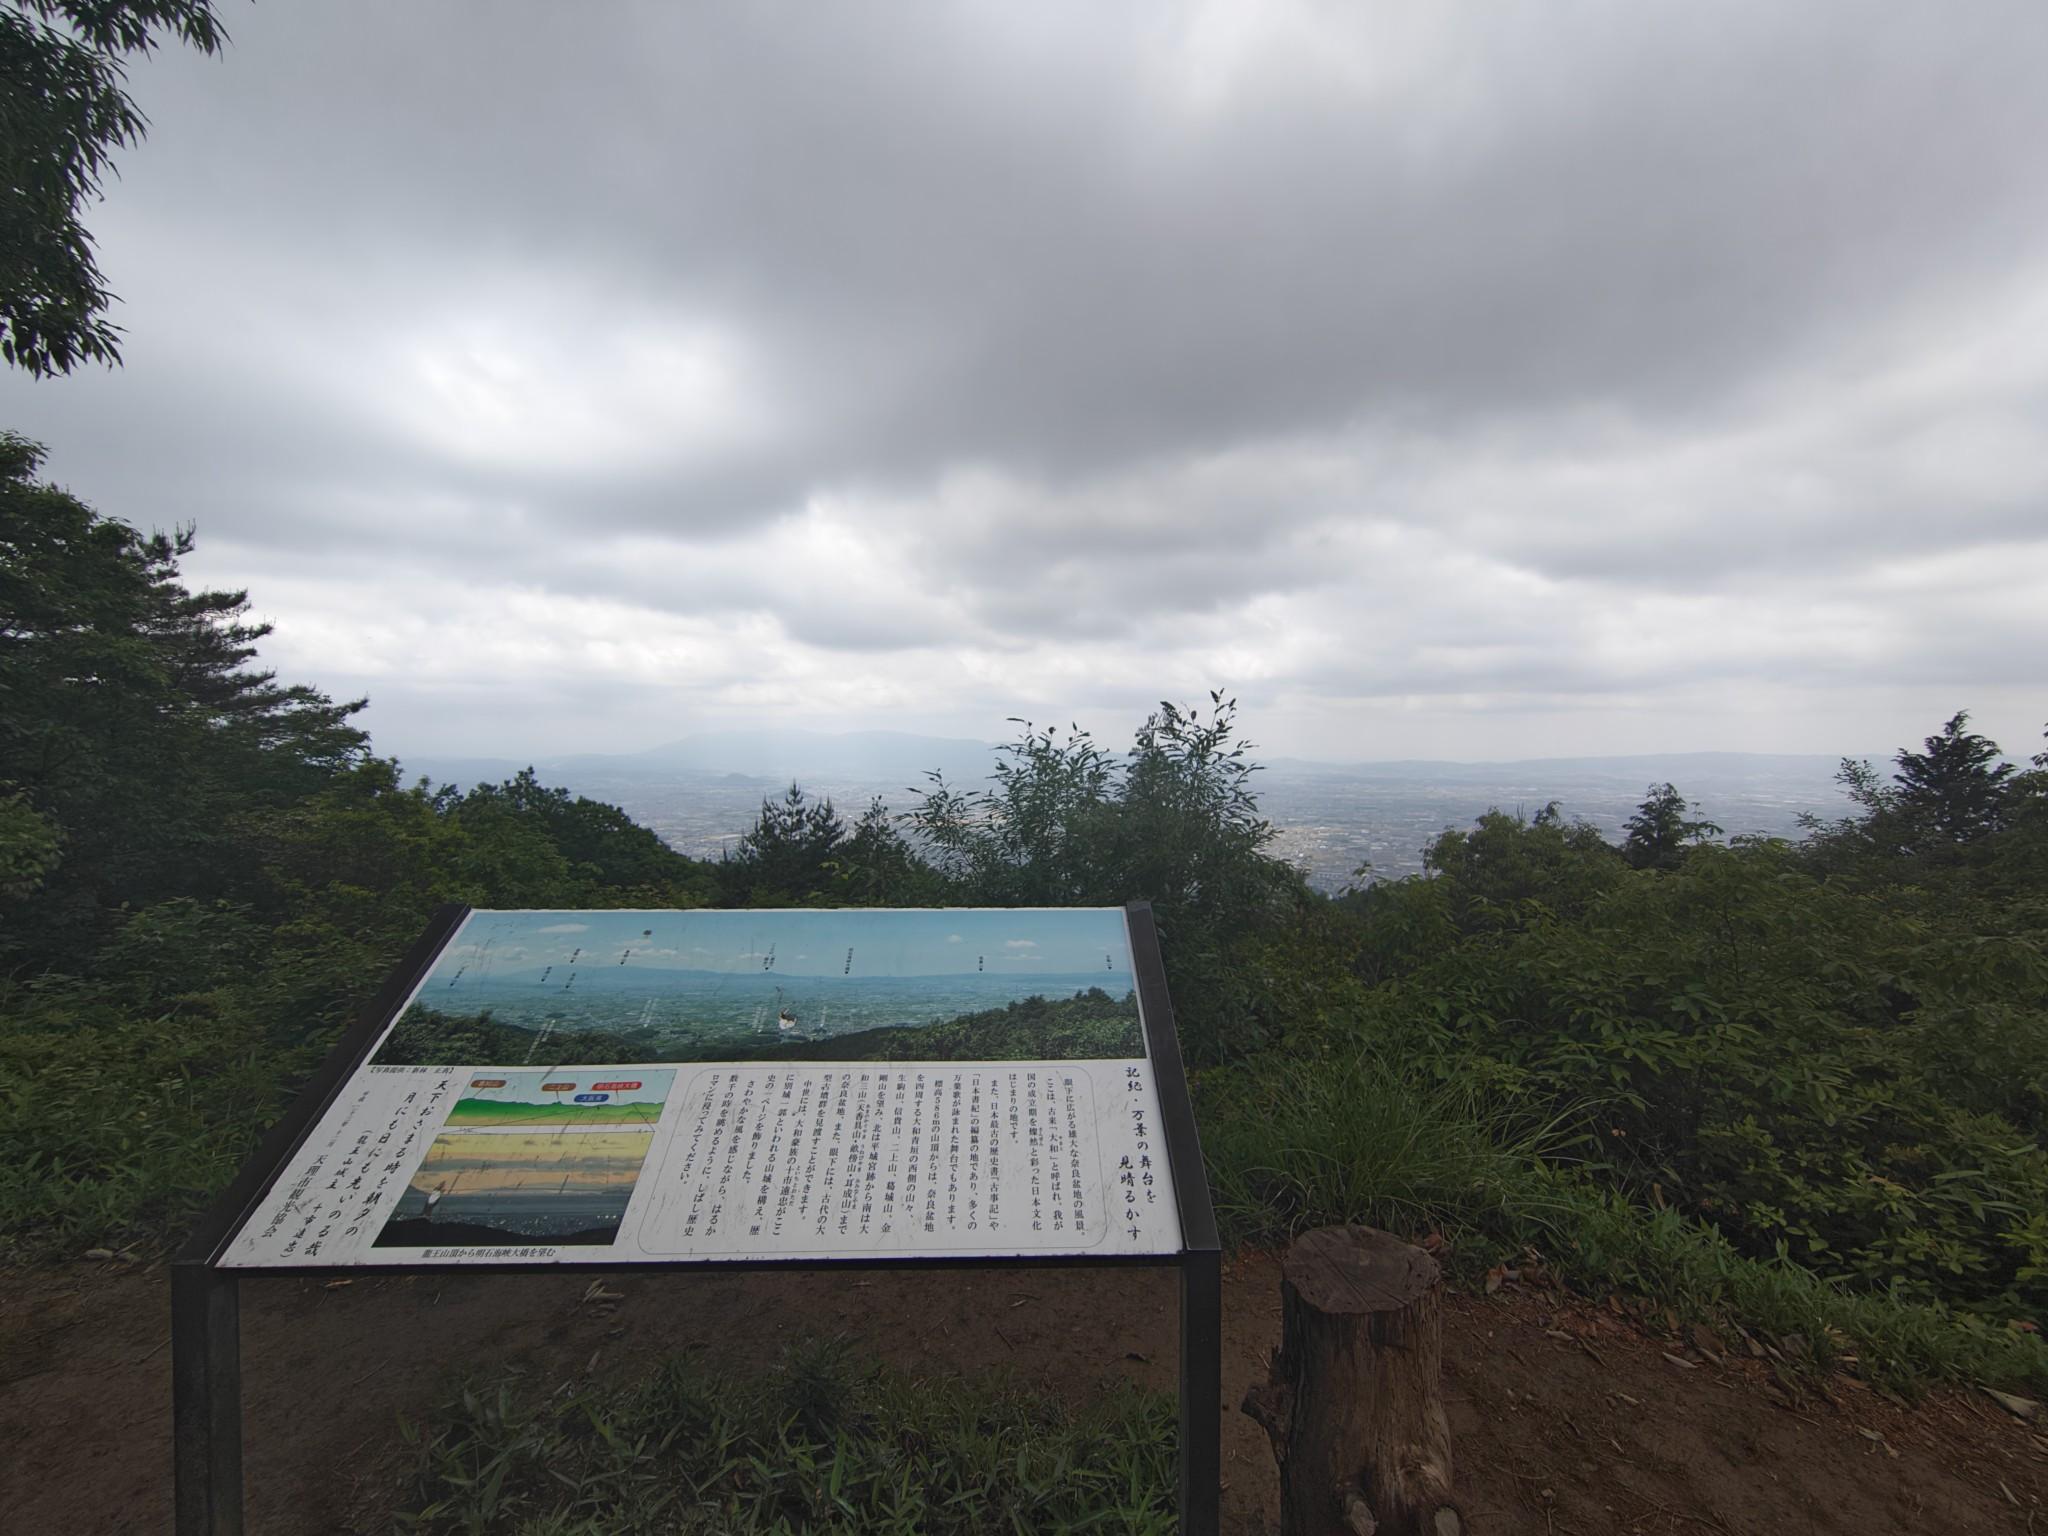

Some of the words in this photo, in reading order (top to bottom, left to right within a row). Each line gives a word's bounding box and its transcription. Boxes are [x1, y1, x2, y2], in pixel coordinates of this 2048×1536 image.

[1008, 1073, 1019, 1144] はじまりの地です。
[1125, 1067, 1157, 1203] 記紀・万葉の舞台を
[261, 1154, 329, 1237] 天理市観光協会
[1063, 1078, 1086, 1236] 眼下に広がる雄大な奈良盆地の風景。
[1118, 1155, 1142, 1240] 見晴るかす
